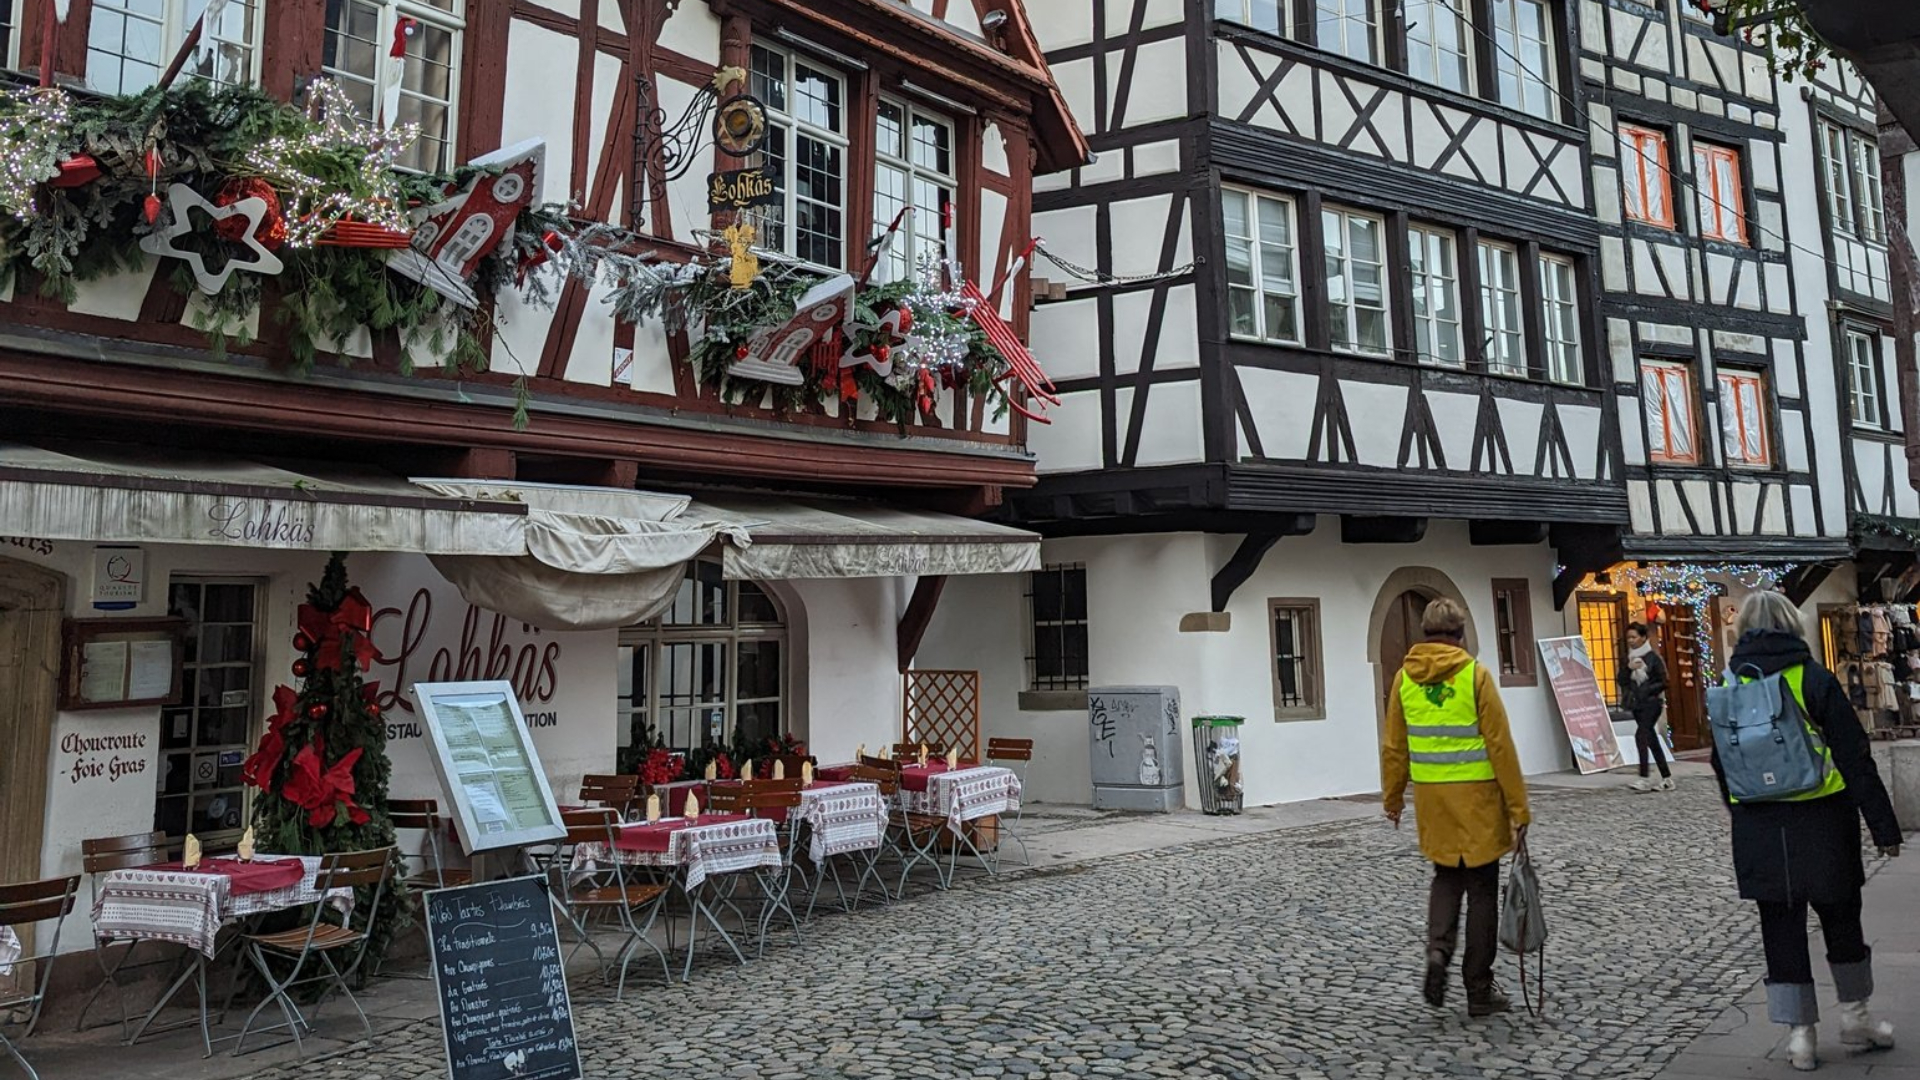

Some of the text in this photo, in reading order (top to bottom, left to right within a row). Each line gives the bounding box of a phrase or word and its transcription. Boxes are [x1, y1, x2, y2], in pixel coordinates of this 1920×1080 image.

[711, 170, 772, 206] Lohkäs
[208, 501, 315, 542] Lohkäs
[0, 536, 53, 555] urs
[61, 732, 146, 755] Choucroute
[109, 755, 146, 782] Gras
